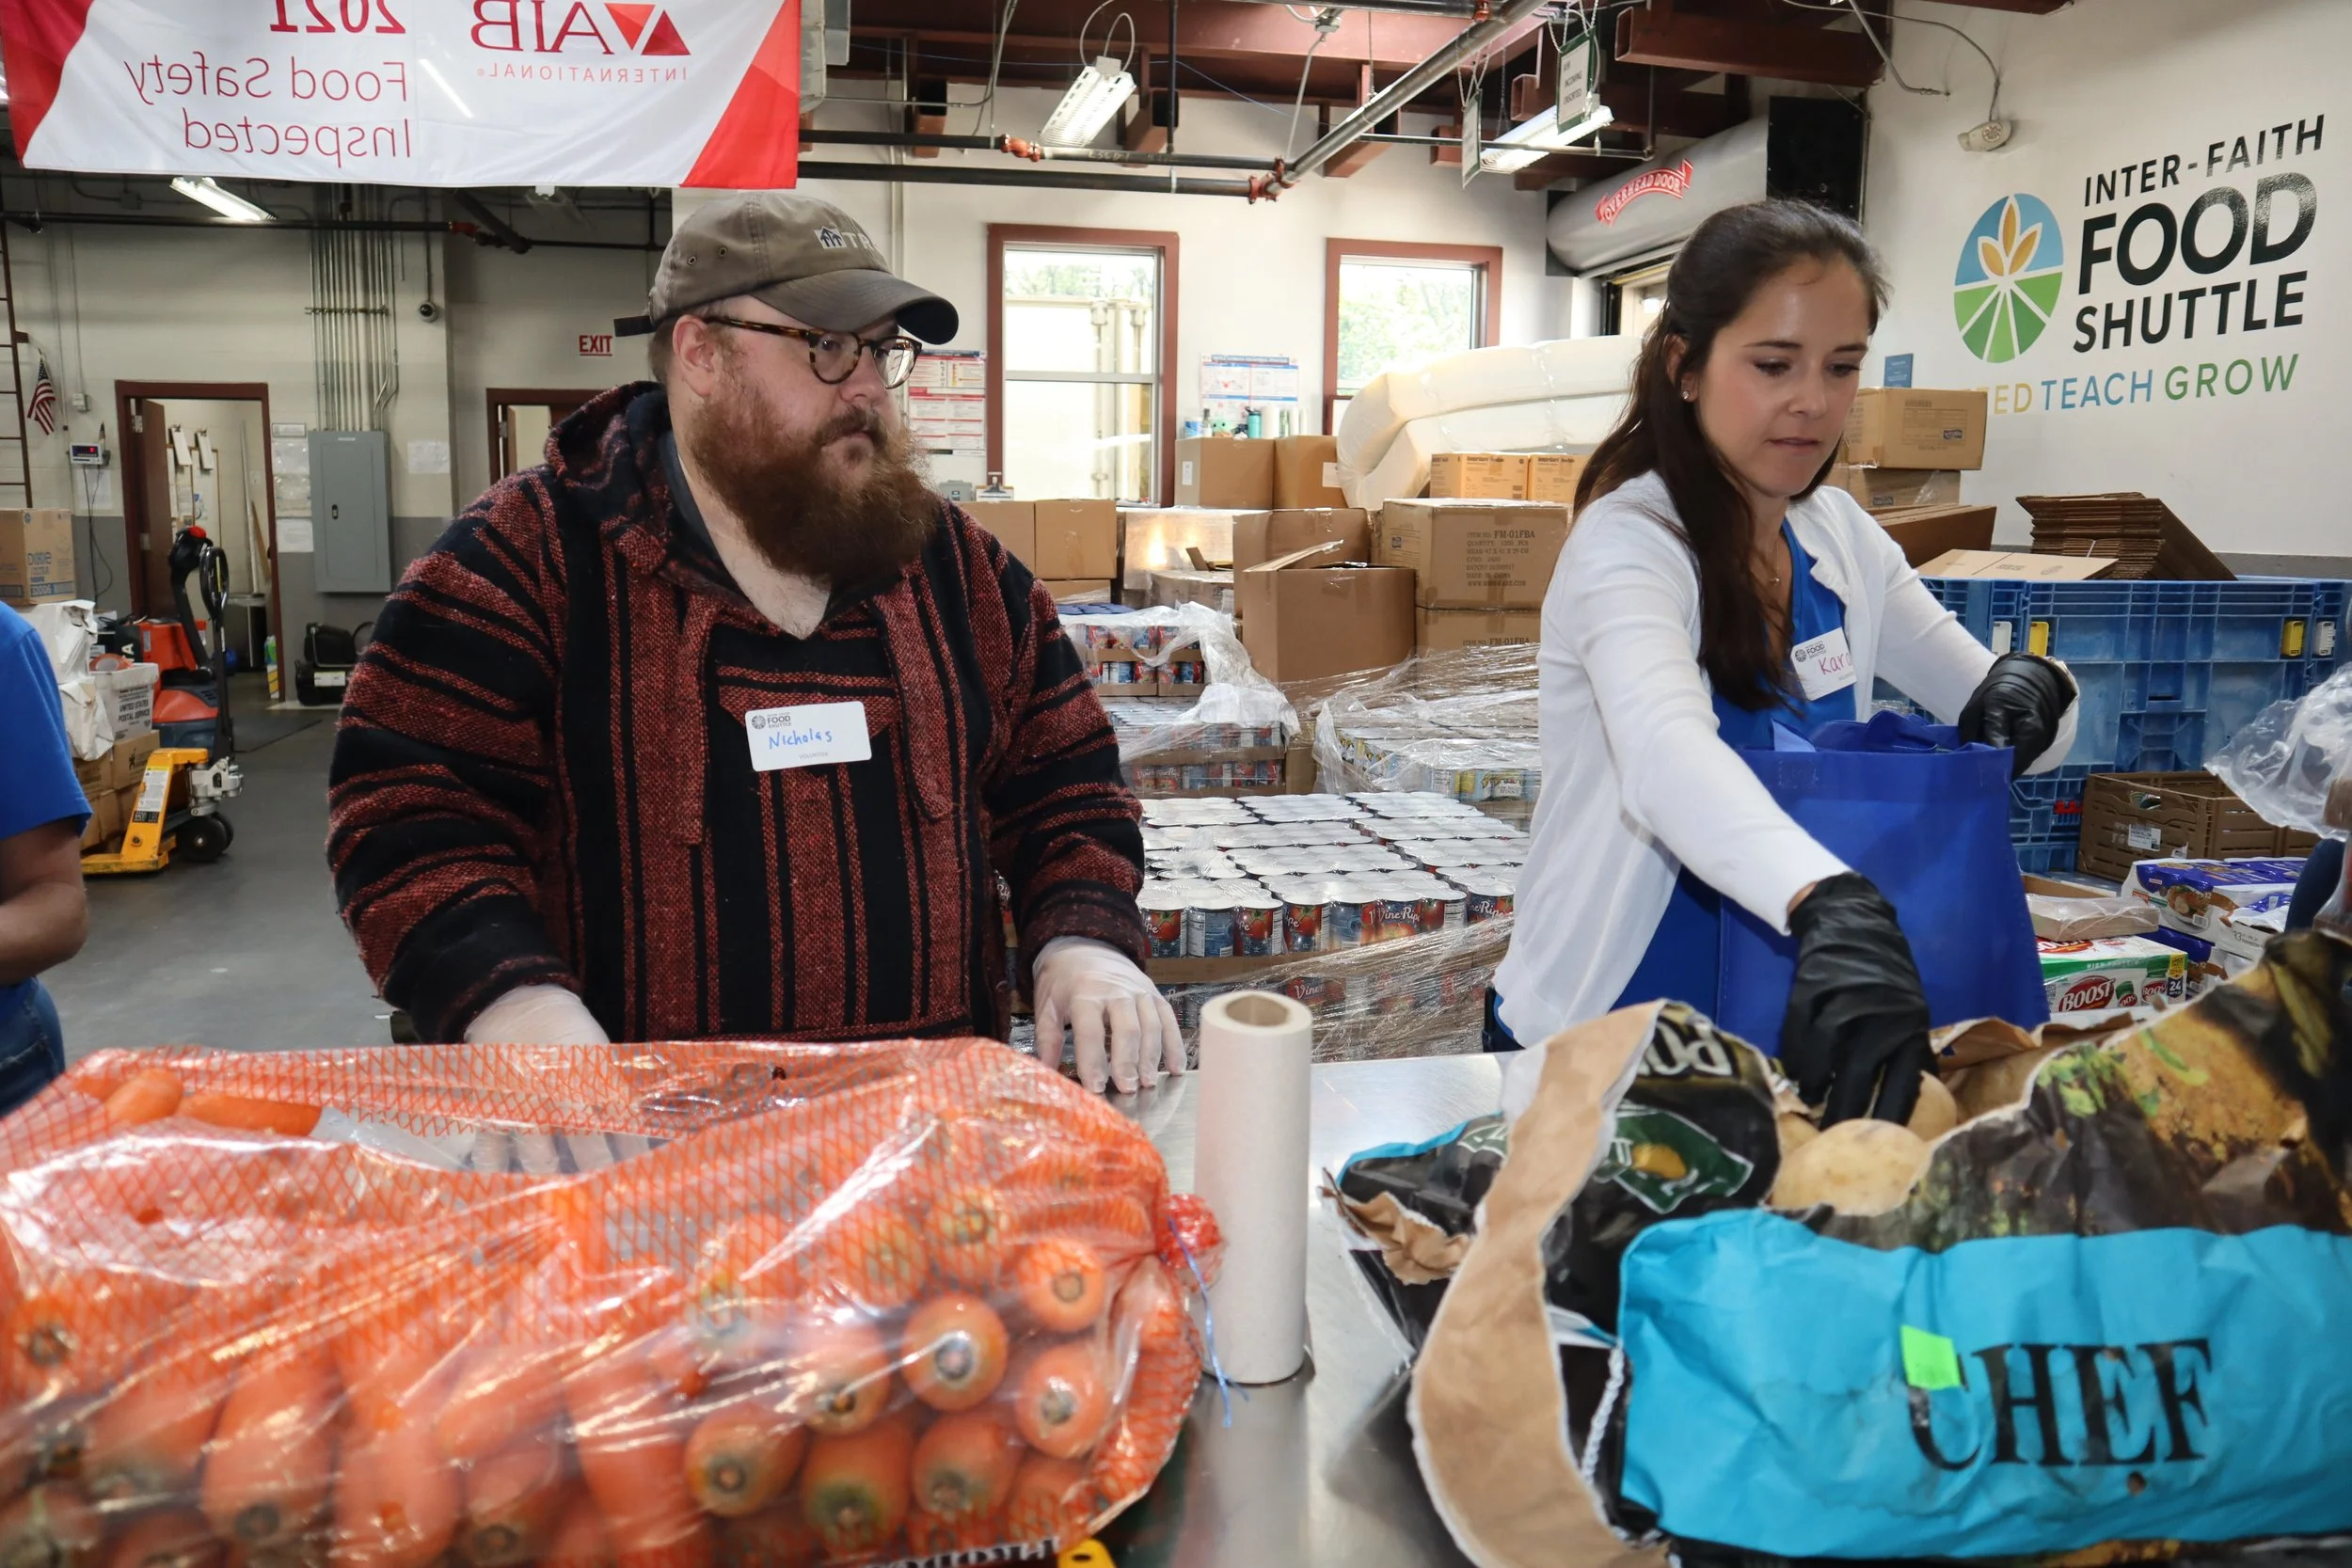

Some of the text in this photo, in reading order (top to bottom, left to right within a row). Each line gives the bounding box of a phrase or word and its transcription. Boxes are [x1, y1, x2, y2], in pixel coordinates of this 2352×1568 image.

[2084, 114, 2325, 207] INTER-FAITH
[1604, 173, 1681, 220] OVERHEAD DOOR
[2078, 171, 2318, 295] FOOD
[2073, 271, 2309, 353] SHUTTLE
[579, 335, 612, 353] EXIT
[1977, 353, 2300, 415] ED TEACH GROW
[1494, 530, 1535, 539] FM-01FBA
[1806, 643, 1825, 656] FOOD
[767, 715, 791, 724] FOOD
[769, 728, 833, 750] Nicholas
[799, 752, 829, 760] VOLUNTEER
[2062, 977, 2117, 1011] BOOST
[2169, 980, 2182, 991] 24
[2120, 993, 2137, 1008] OOS
[1907, 1338, 2212, 1472] CHEF
